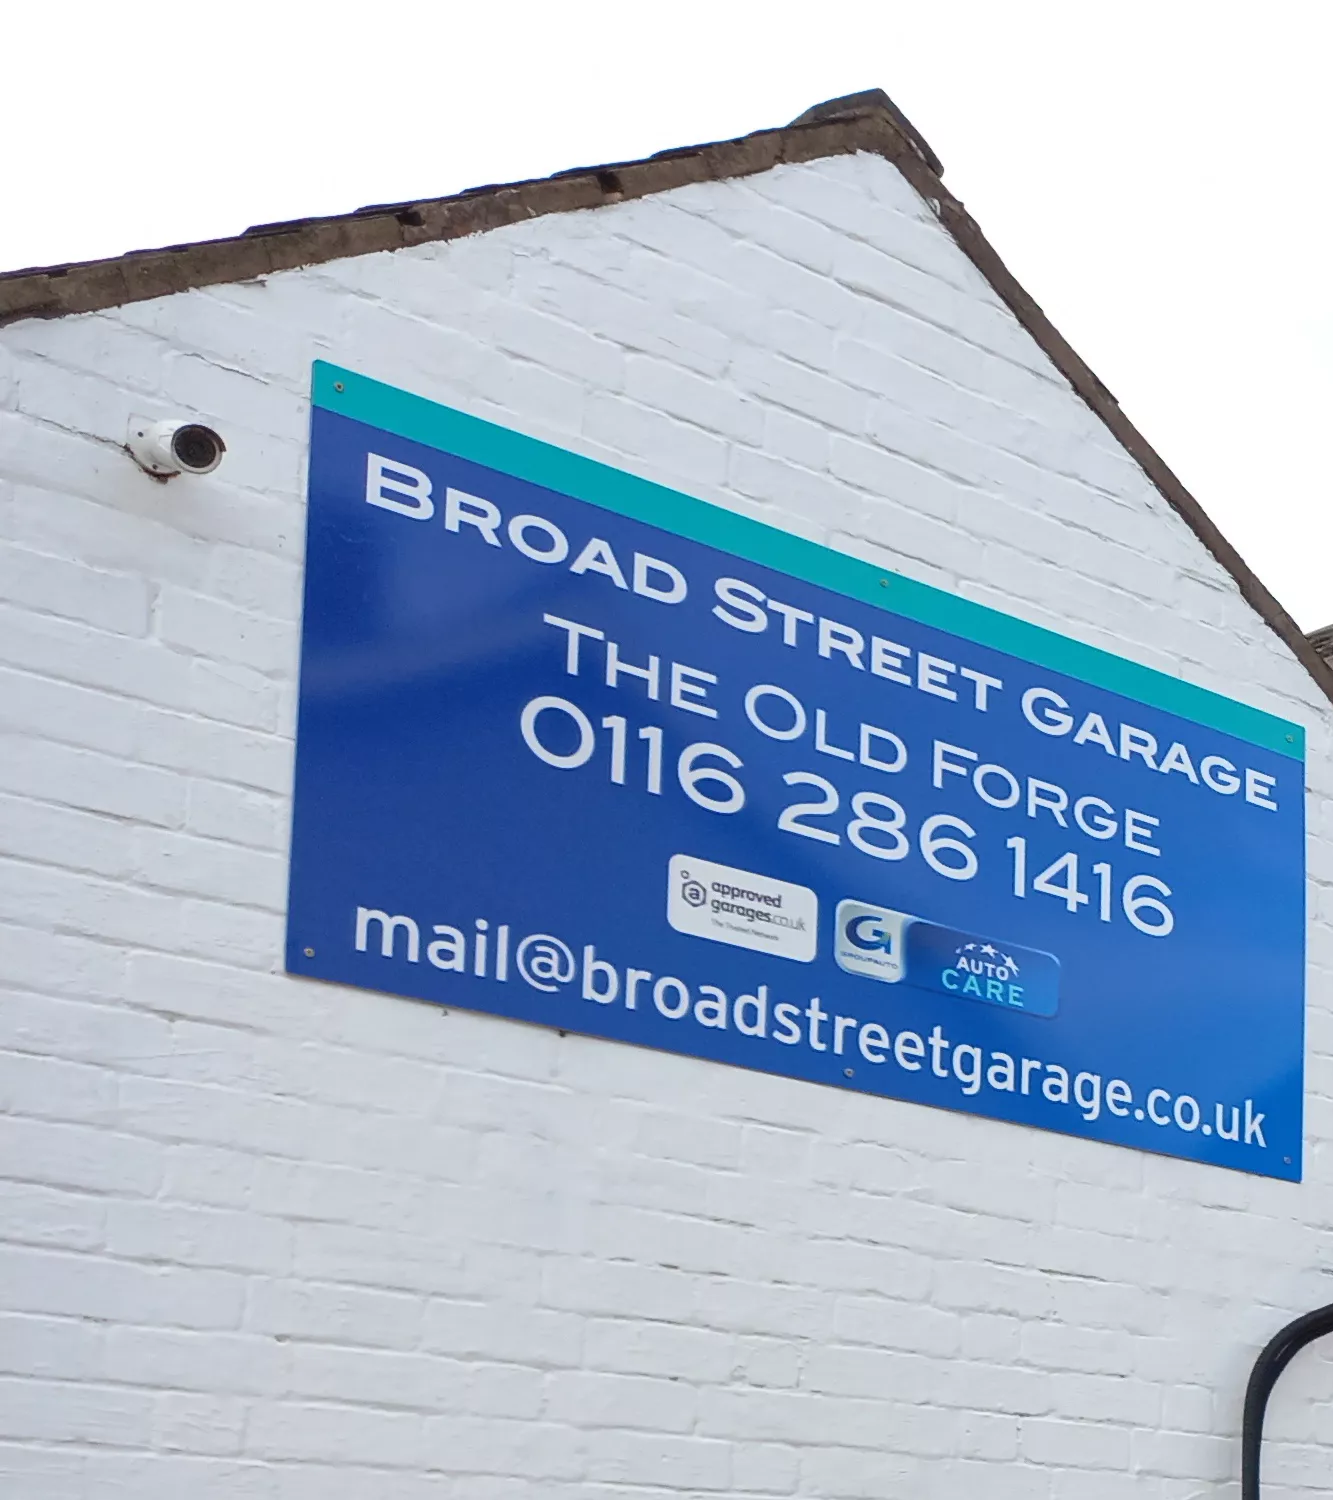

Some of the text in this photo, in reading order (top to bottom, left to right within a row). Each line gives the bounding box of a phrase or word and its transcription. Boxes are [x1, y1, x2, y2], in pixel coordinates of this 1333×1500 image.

[364, 451, 1278, 812] BROAD STREET GARAGE
[542, 612, 1162, 858] THE OLD FORGE
[519, 695, 1175, 938] 0116 286 1416
[710, 897, 807, 932] garages.co.uk
[711, 880, 782, 909] approved
[354, 905, 1267, 1148] mail@broadstreetgarage.co.uk
[941, 968, 1026, 1009] CARE
[955, 955, 1011, 982] AUTO
